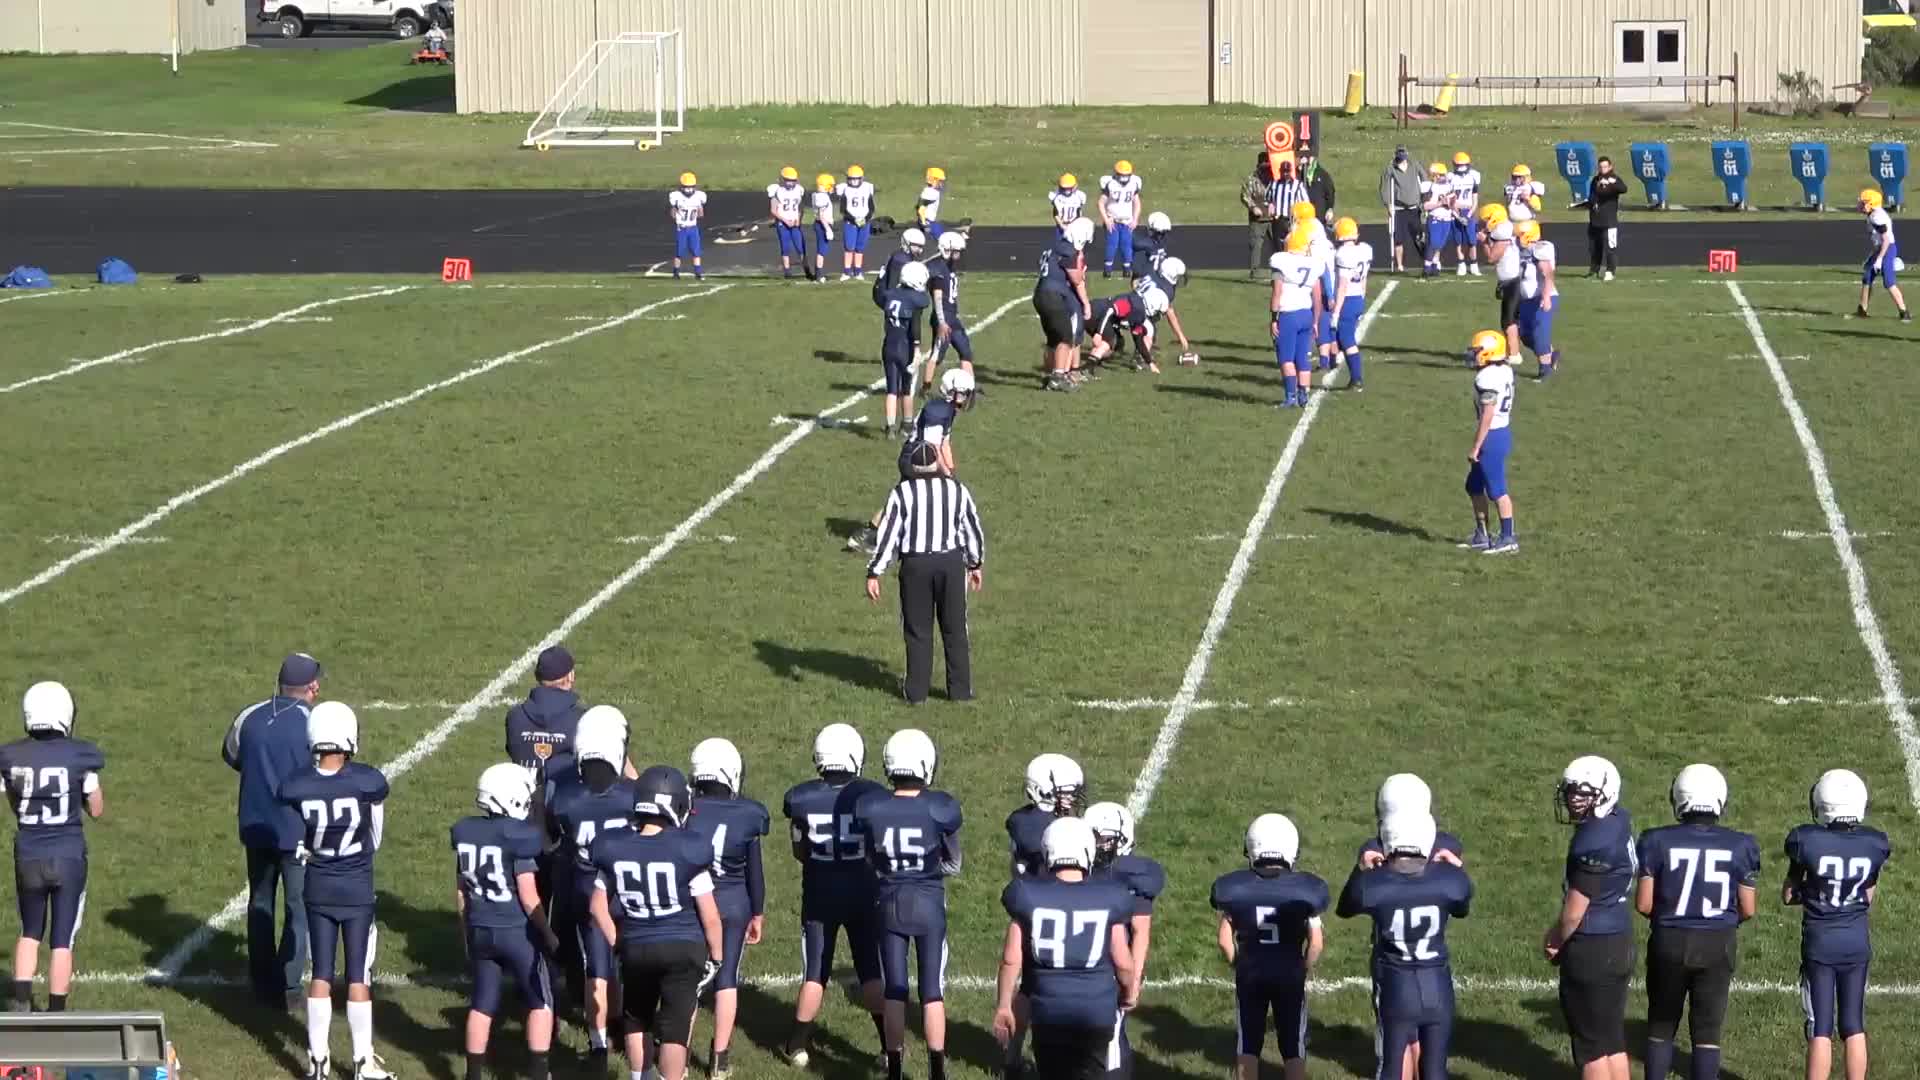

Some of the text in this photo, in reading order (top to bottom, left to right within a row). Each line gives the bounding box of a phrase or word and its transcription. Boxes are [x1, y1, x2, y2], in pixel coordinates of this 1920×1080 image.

[851, 196, 865, 208] 61
[446, 260, 467, 280] 30
[1297, 266, 1311, 288] 7
[1711, 252, 1733, 272] 50
[11, 766, 70, 825] 23
[301, 797, 363, 857] 22
[807, 813, 865, 861] 55
[882, 827, 925, 872] 15
[613, 861, 682, 919] 60
[1669, 848, 1733, 918] 75
[1255, 906, 1280, 944] 5
